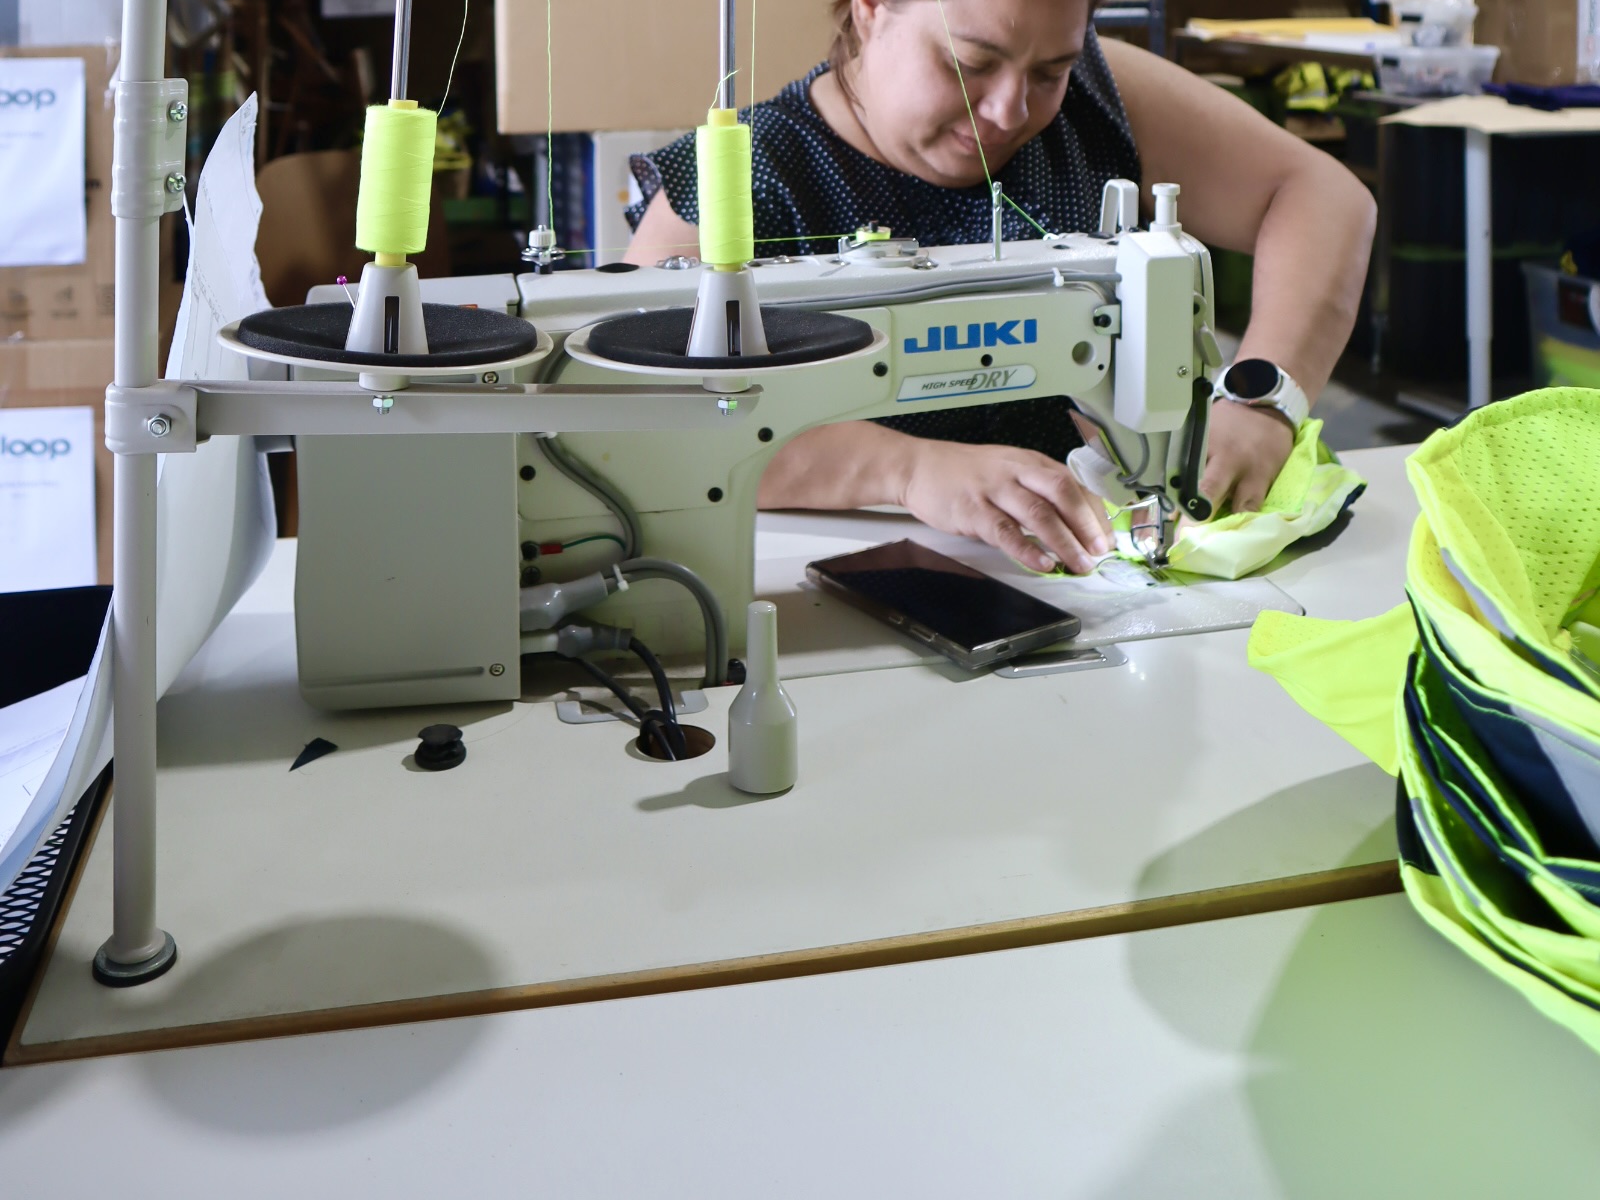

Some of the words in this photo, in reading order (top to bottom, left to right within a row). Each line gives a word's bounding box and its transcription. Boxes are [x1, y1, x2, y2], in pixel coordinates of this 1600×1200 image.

[904, 319, 1038, 354] JUKI
[921, 381, 947, 391] HIGH
[948, 377, 978, 388] SPEED
[967, 368, 1018, 391] DRY
[1, 435, 71, 460] loop
